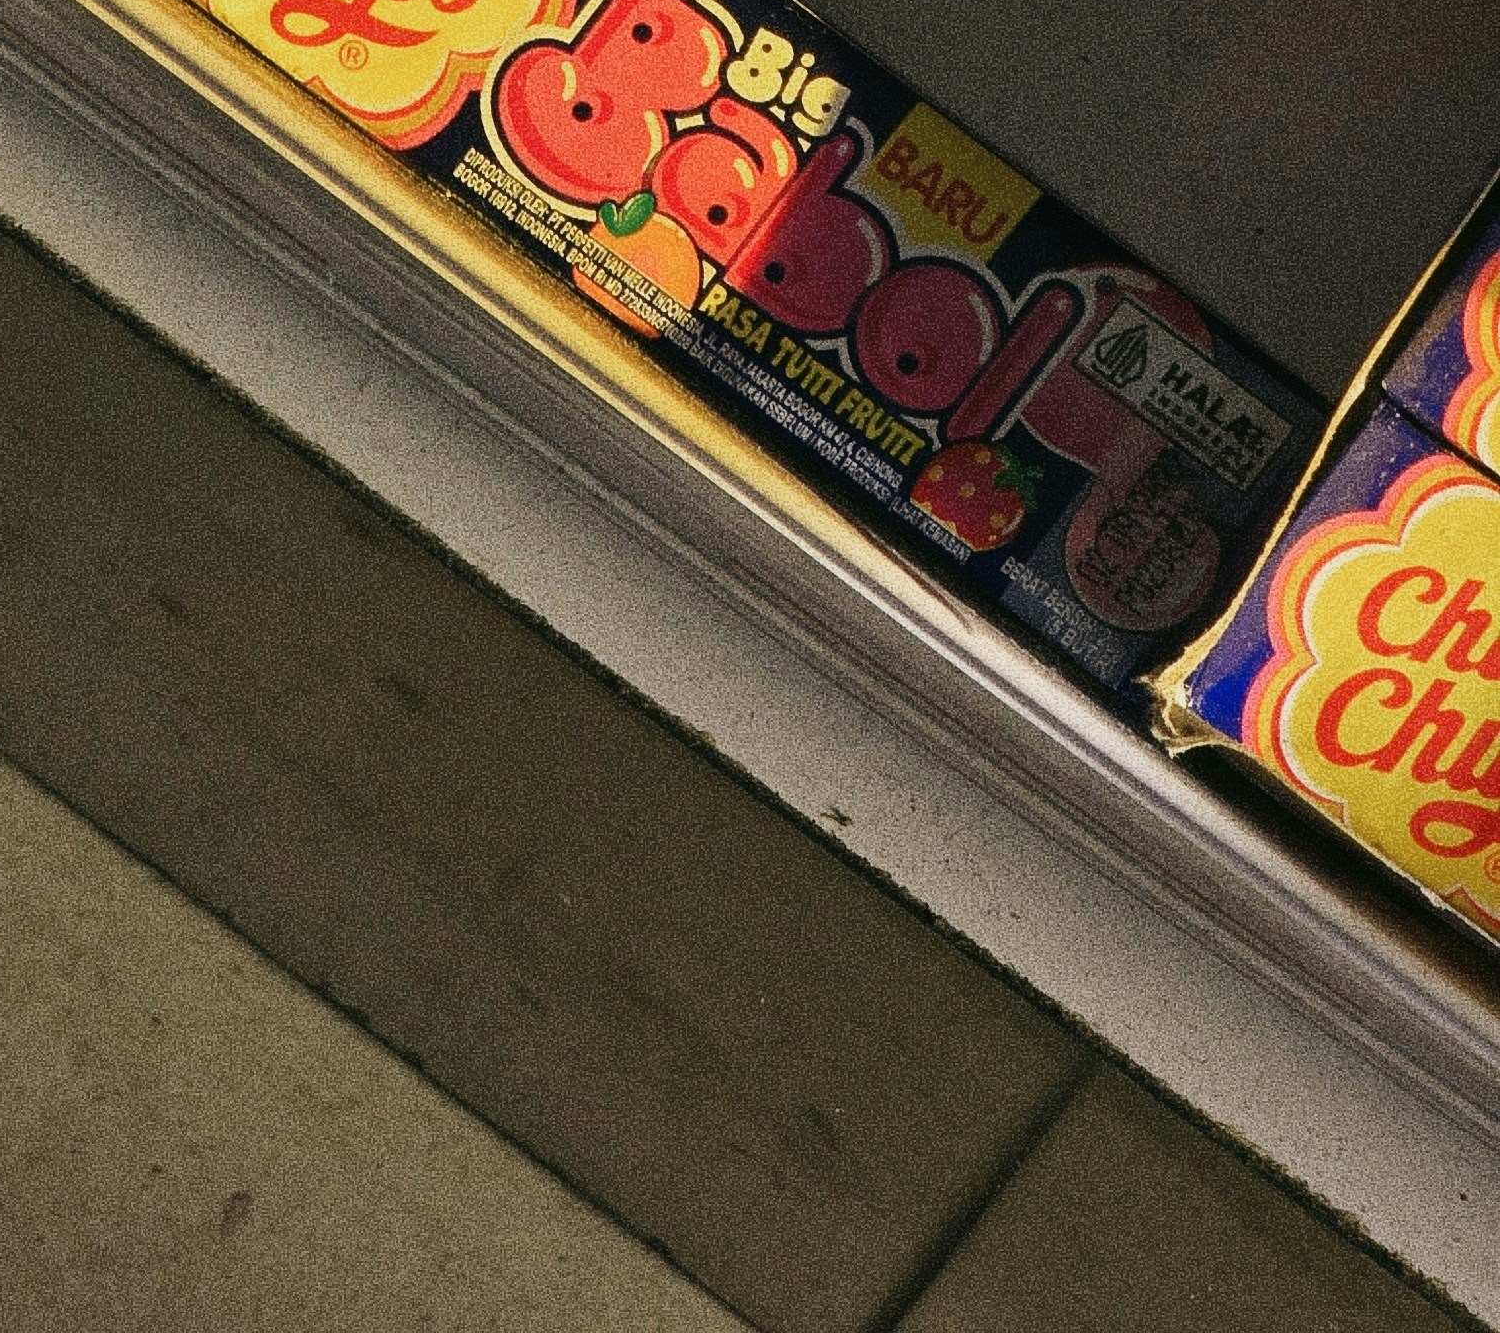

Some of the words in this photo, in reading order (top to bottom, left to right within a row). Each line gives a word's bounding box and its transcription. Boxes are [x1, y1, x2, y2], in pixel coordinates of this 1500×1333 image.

[728, 33, 850, 136] Big
[453, 164, 491, 196] BOGOR
[566, 248, 596, 275] BPOM
[462, 148, 524, 198] DIPRODUKSI
[545, 211, 565, 231] PT
[560, 223, 606, 261] PERFETTI
[621, 269, 657, 300] MELLE
[876, 138, 1006, 245] BARU
[699, 283, 777, 351] RASA
[767, 337, 845, 404] TUTTI
[834, 387, 926, 465] FRUTTI
[1000, 557, 1048, 597] BERAT
